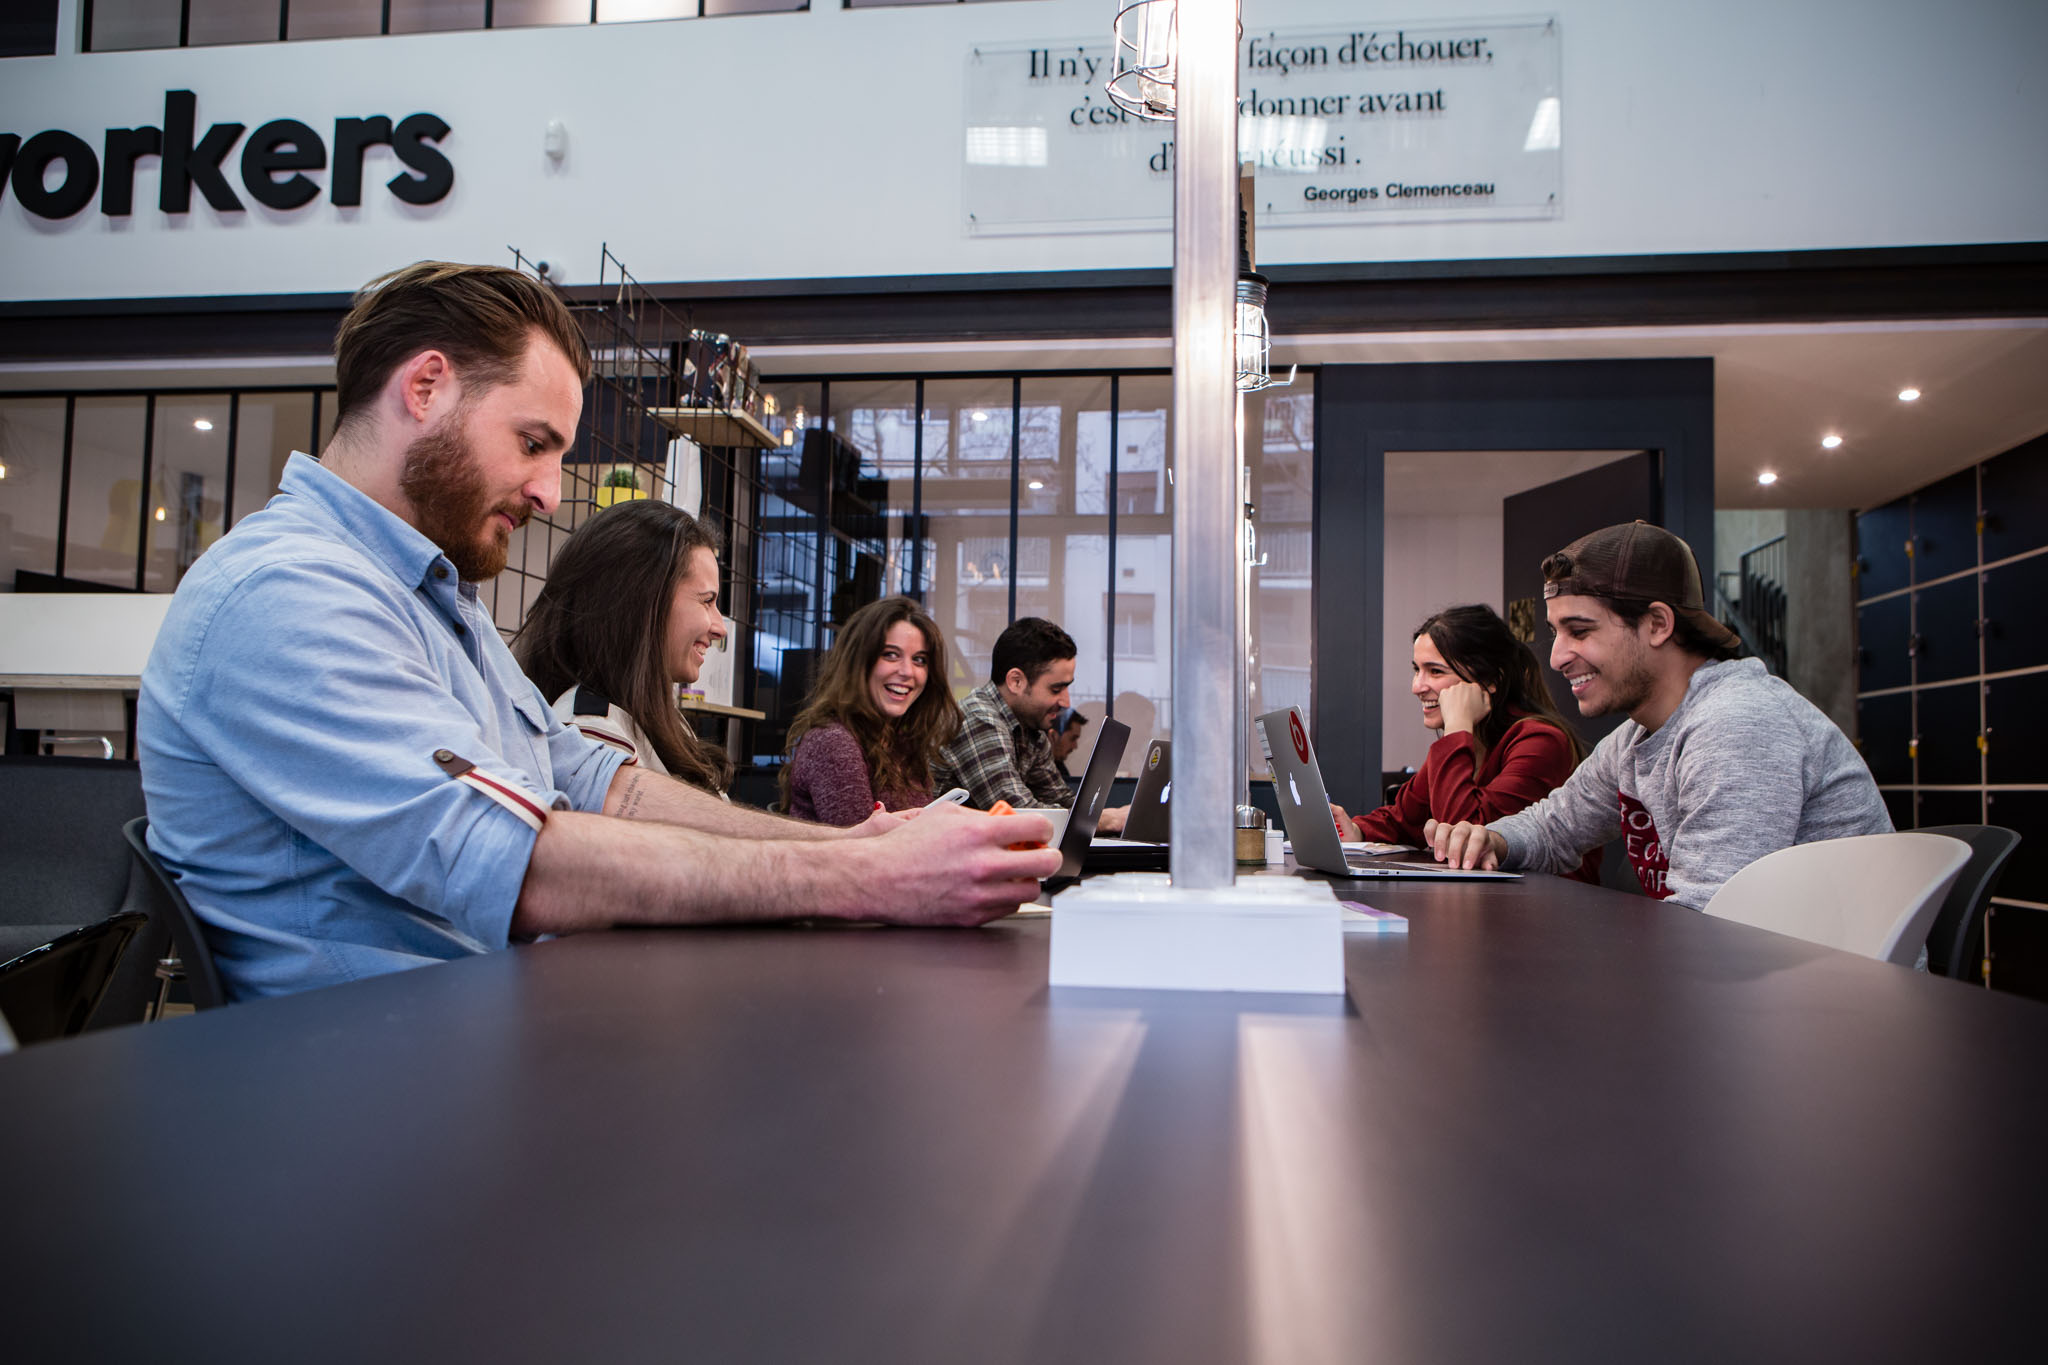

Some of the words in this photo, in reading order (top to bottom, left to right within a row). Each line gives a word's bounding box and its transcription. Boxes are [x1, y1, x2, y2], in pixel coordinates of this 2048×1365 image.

[1028, 49, 1049, 79] Il
[1248, 38, 1328, 75] façon
[1338, 31, 1494, 65] d'échouer,
[1359, 88, 1447, 115] avant
[1304, 185, 1379, 204] Georges
[1385, 181, 1496, 199] Clemenceau
